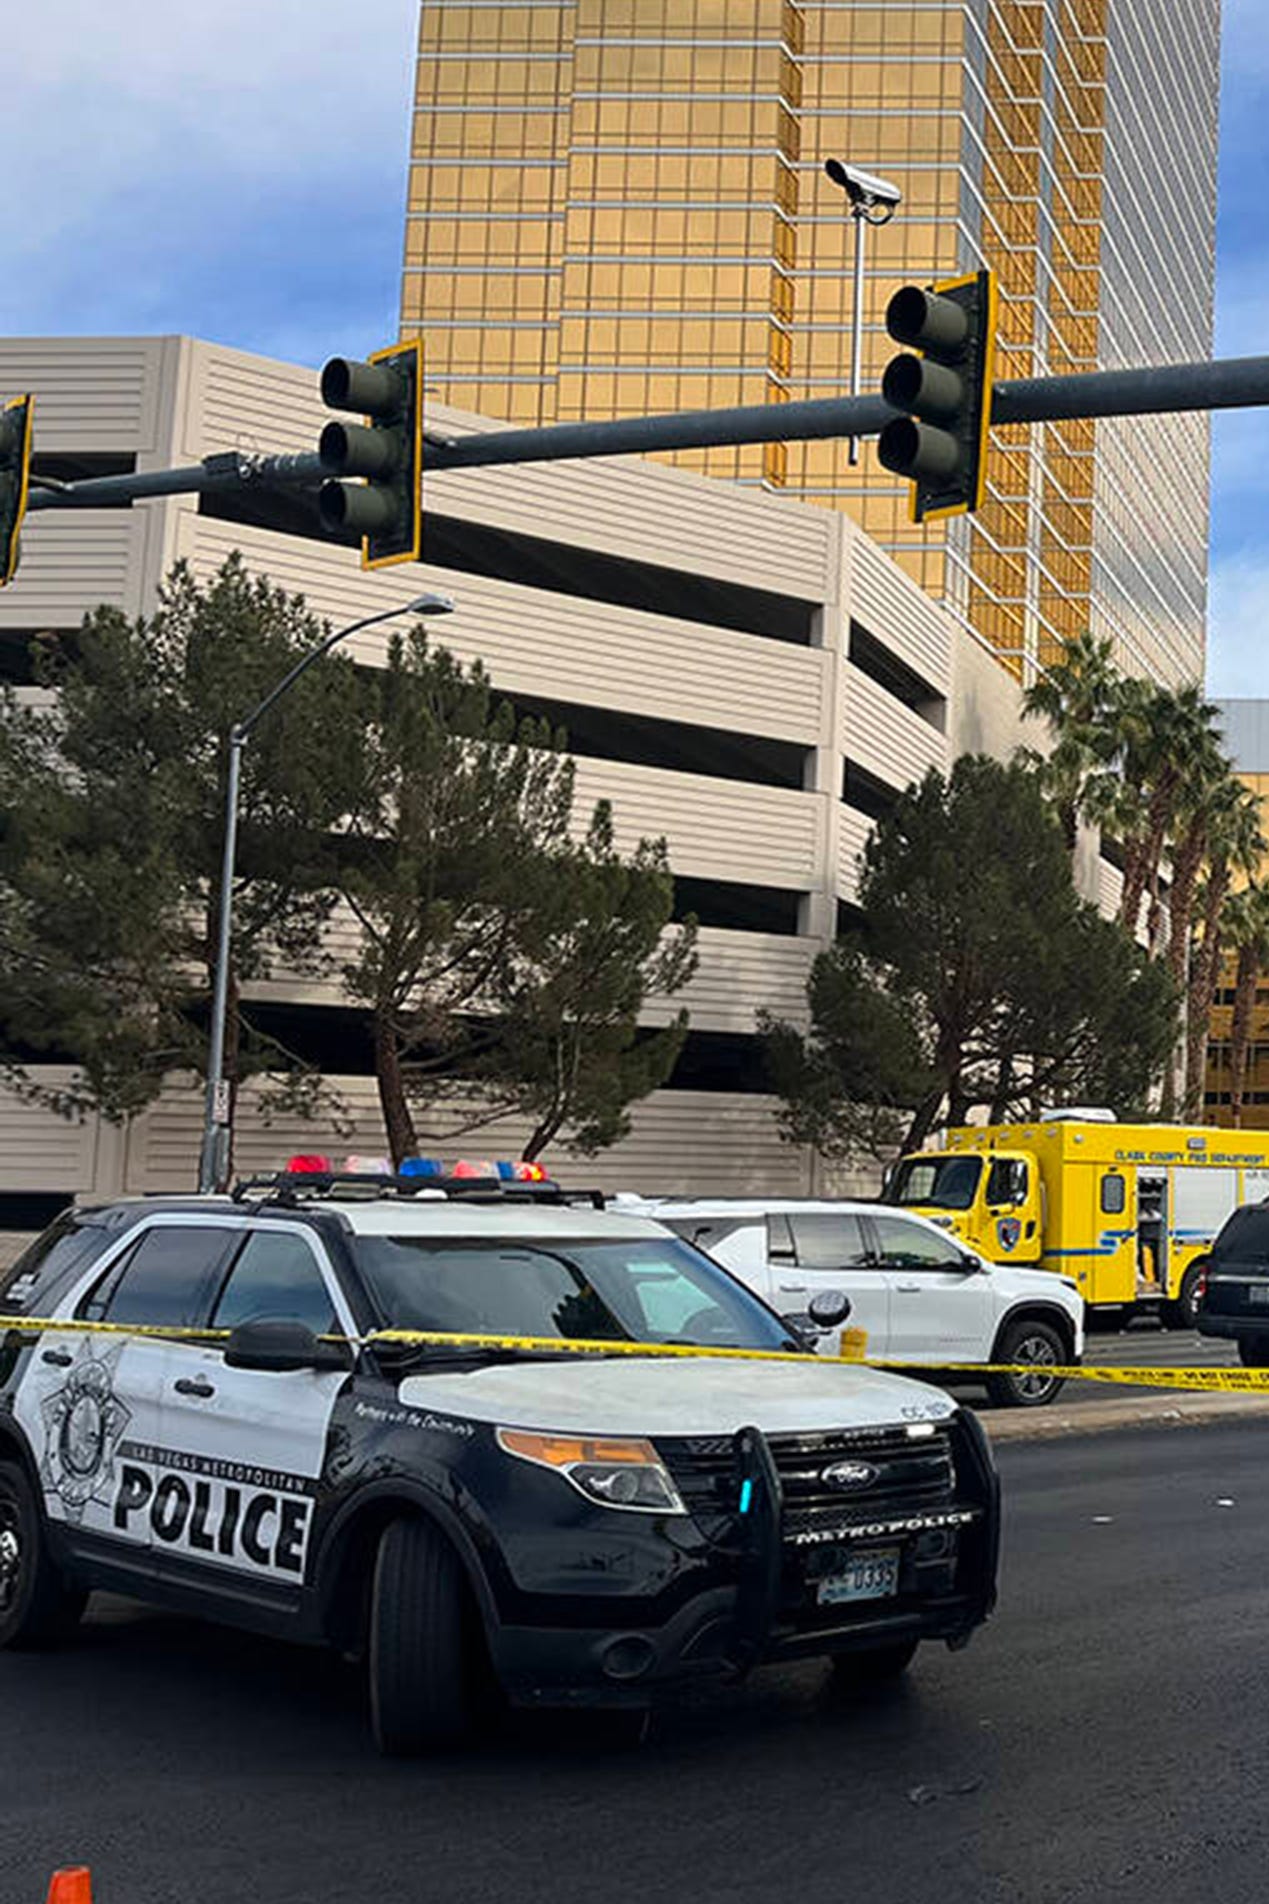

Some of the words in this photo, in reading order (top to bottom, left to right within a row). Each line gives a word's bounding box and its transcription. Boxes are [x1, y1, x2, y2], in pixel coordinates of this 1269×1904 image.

[1149, 1151, 1184, 1162] COUNTY
[133, 1446, 154, 1463] LAS
[158, 1450, 198, 1471] VEGAS
[202, 1460, 307, 1493] METROPOLITAN
[113, 1464, 308, 1574] POLICE
